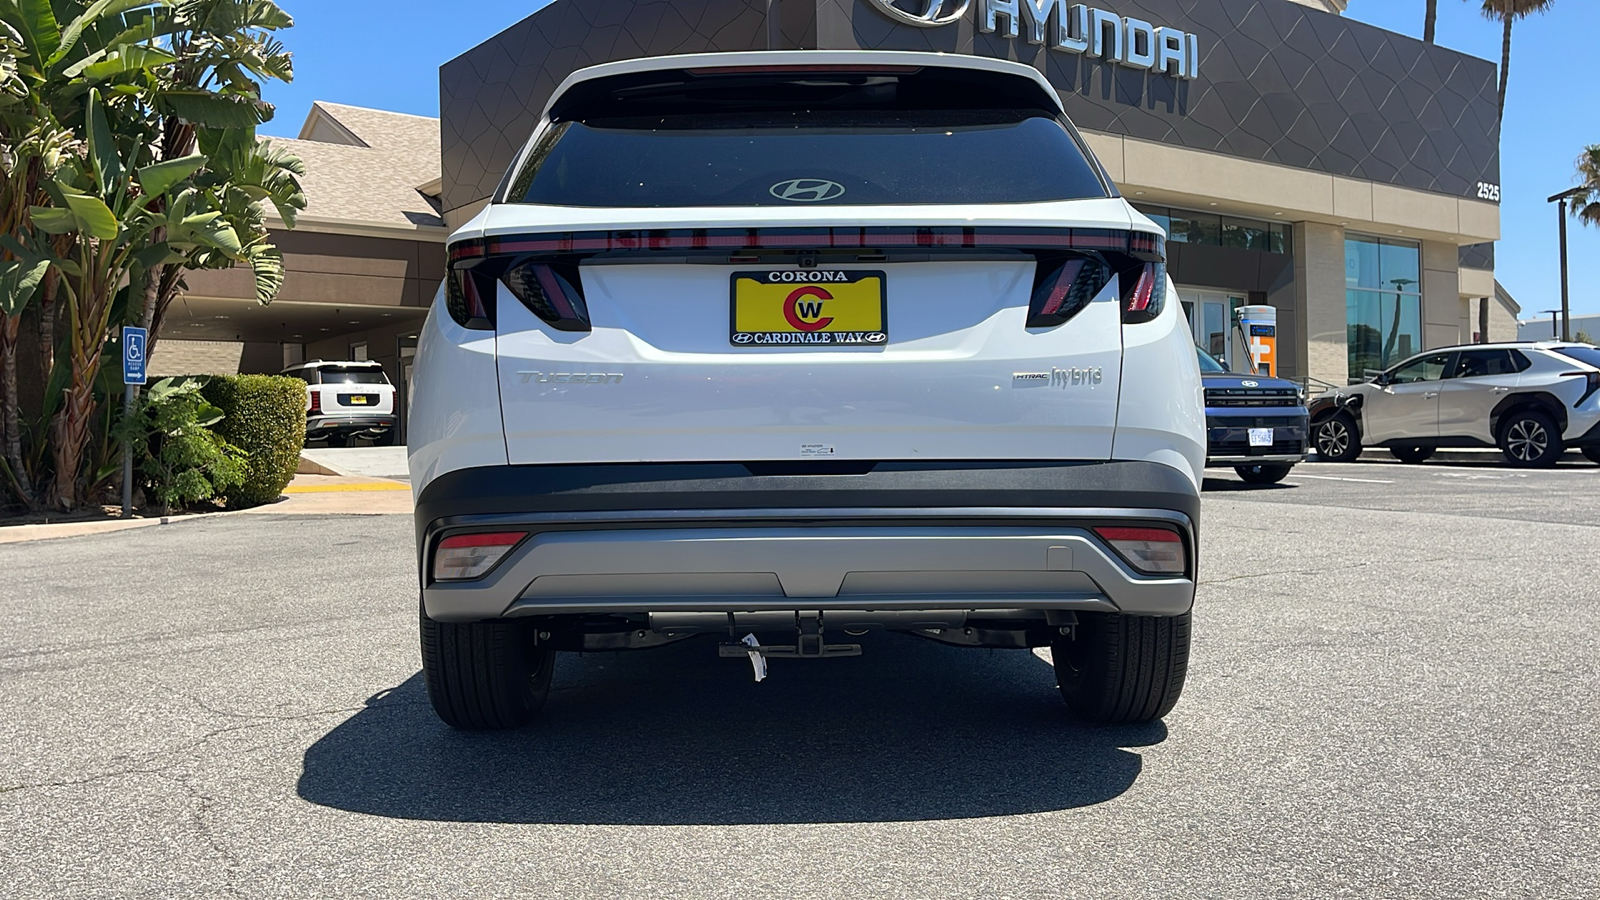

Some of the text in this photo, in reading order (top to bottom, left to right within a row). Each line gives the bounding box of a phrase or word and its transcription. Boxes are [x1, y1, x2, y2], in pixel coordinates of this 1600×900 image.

[979, 0, 1198, 80] HYUNDAI
[1477, 181, 1500, 201] 2525
[768, 271, 848, 282] CORONA
[783, 286, 834, 332] C
[798, 300, 823, 318] W
[754, 332, 864, 343] CARDINALE WAY
[1051, 366, 1102, 390] hybrid
